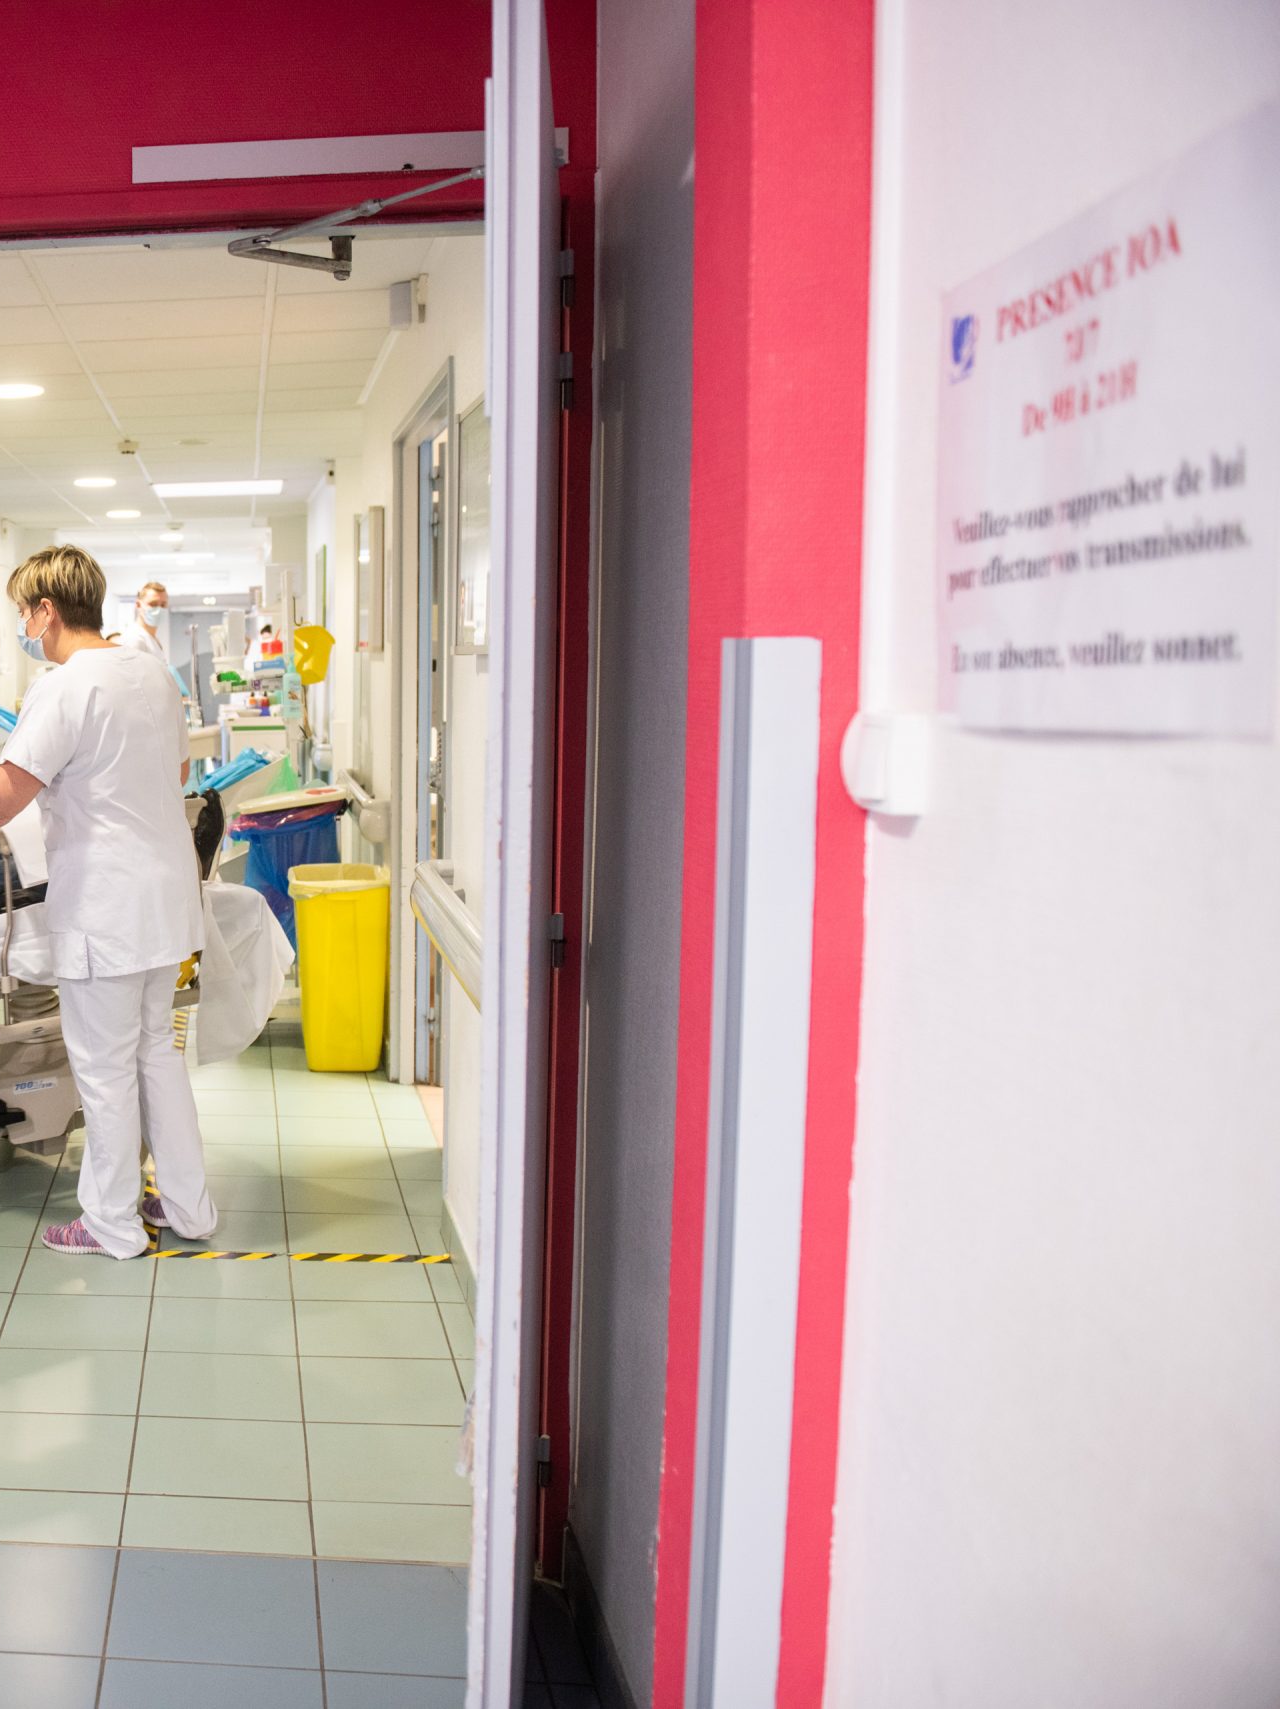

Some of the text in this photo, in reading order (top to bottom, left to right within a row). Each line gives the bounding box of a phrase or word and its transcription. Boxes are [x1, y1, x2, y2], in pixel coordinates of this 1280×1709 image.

[996, 246, 1120, 343] PRESENCE
[1057, 473, 1165, 530] rapprocher
[1173, 459, 1201, 498] de
[1210, 443, 1246, 490] lui
[948, 569, 976, 600] pour
[981, 554, 1052, 587] effectuer
[1069, 632, 1146, 667] veuillez
